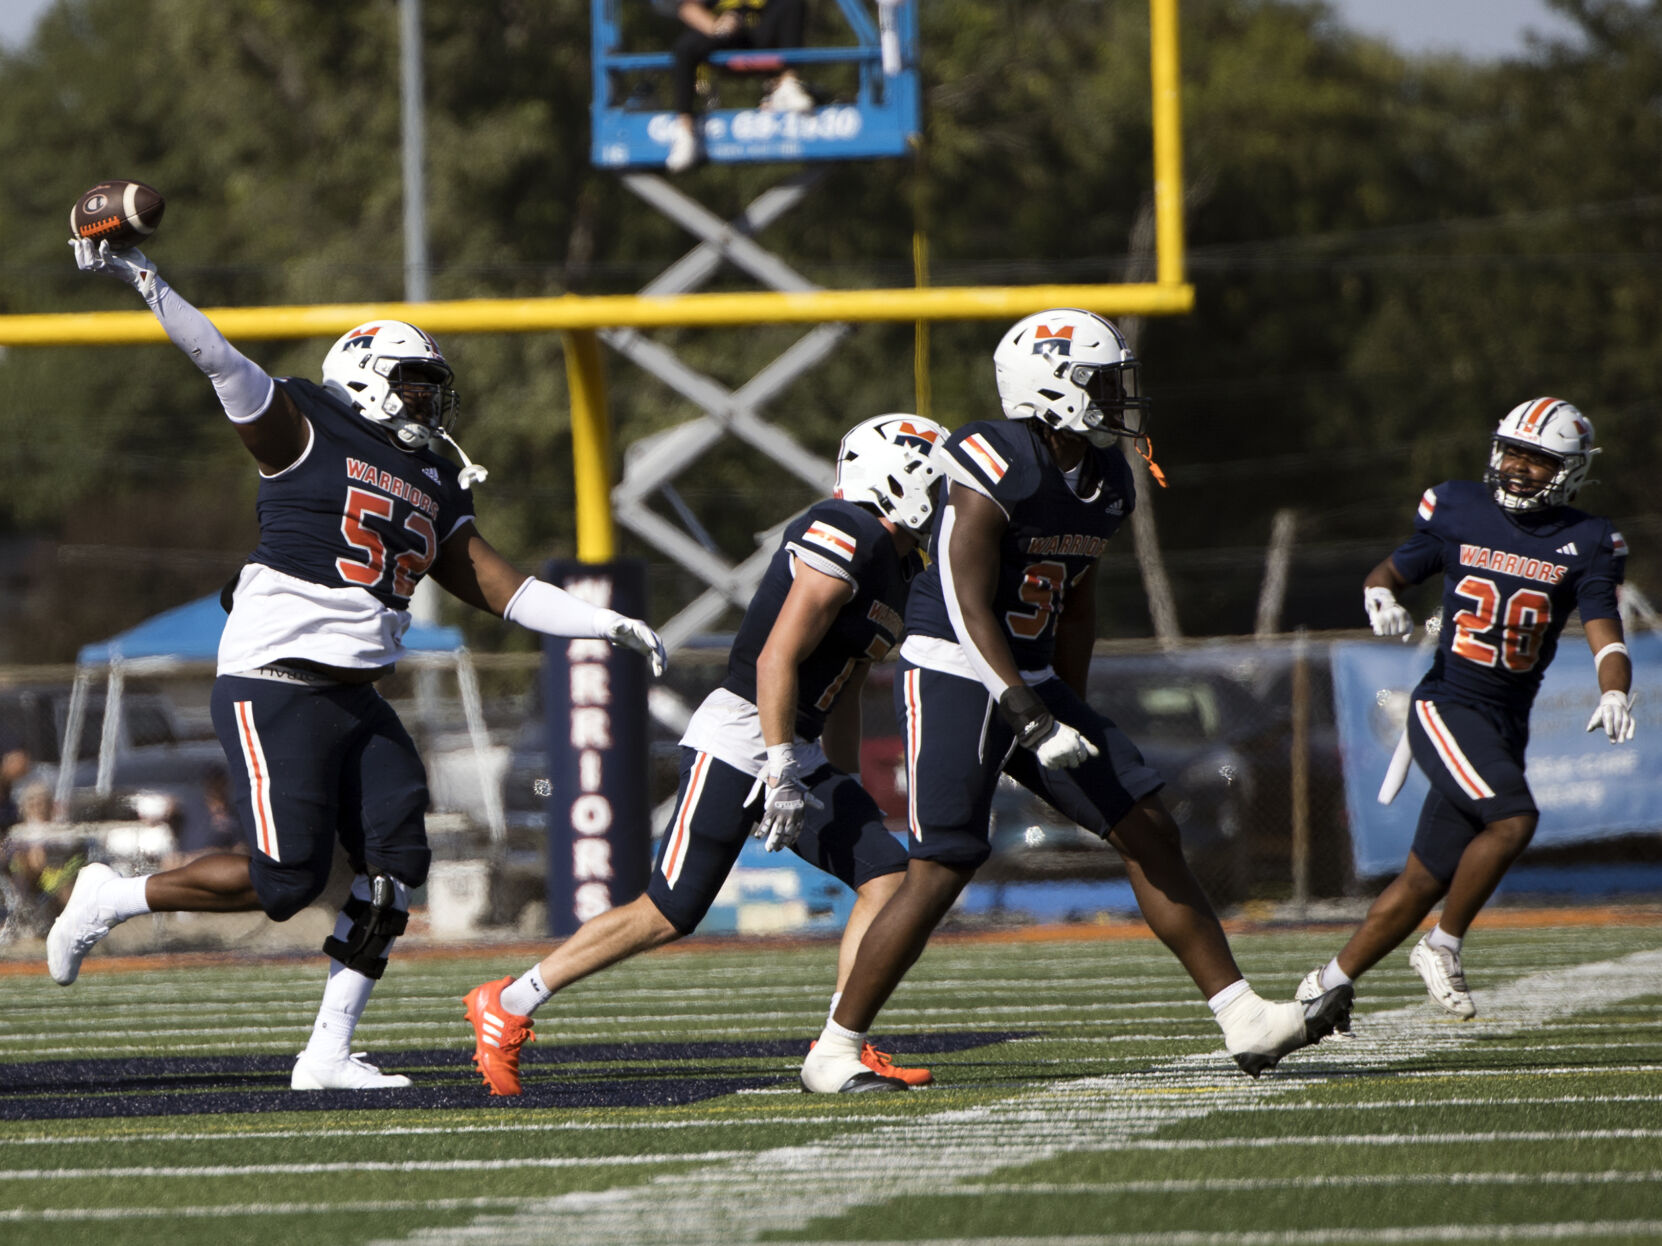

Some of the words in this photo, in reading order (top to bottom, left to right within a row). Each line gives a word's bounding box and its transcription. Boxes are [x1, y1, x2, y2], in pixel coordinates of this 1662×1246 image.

[346, 457, 439, 521] WARRIORS
[335, 486, 437, 599] 52
[1459, 543, 1569, 585] WARRIORS
